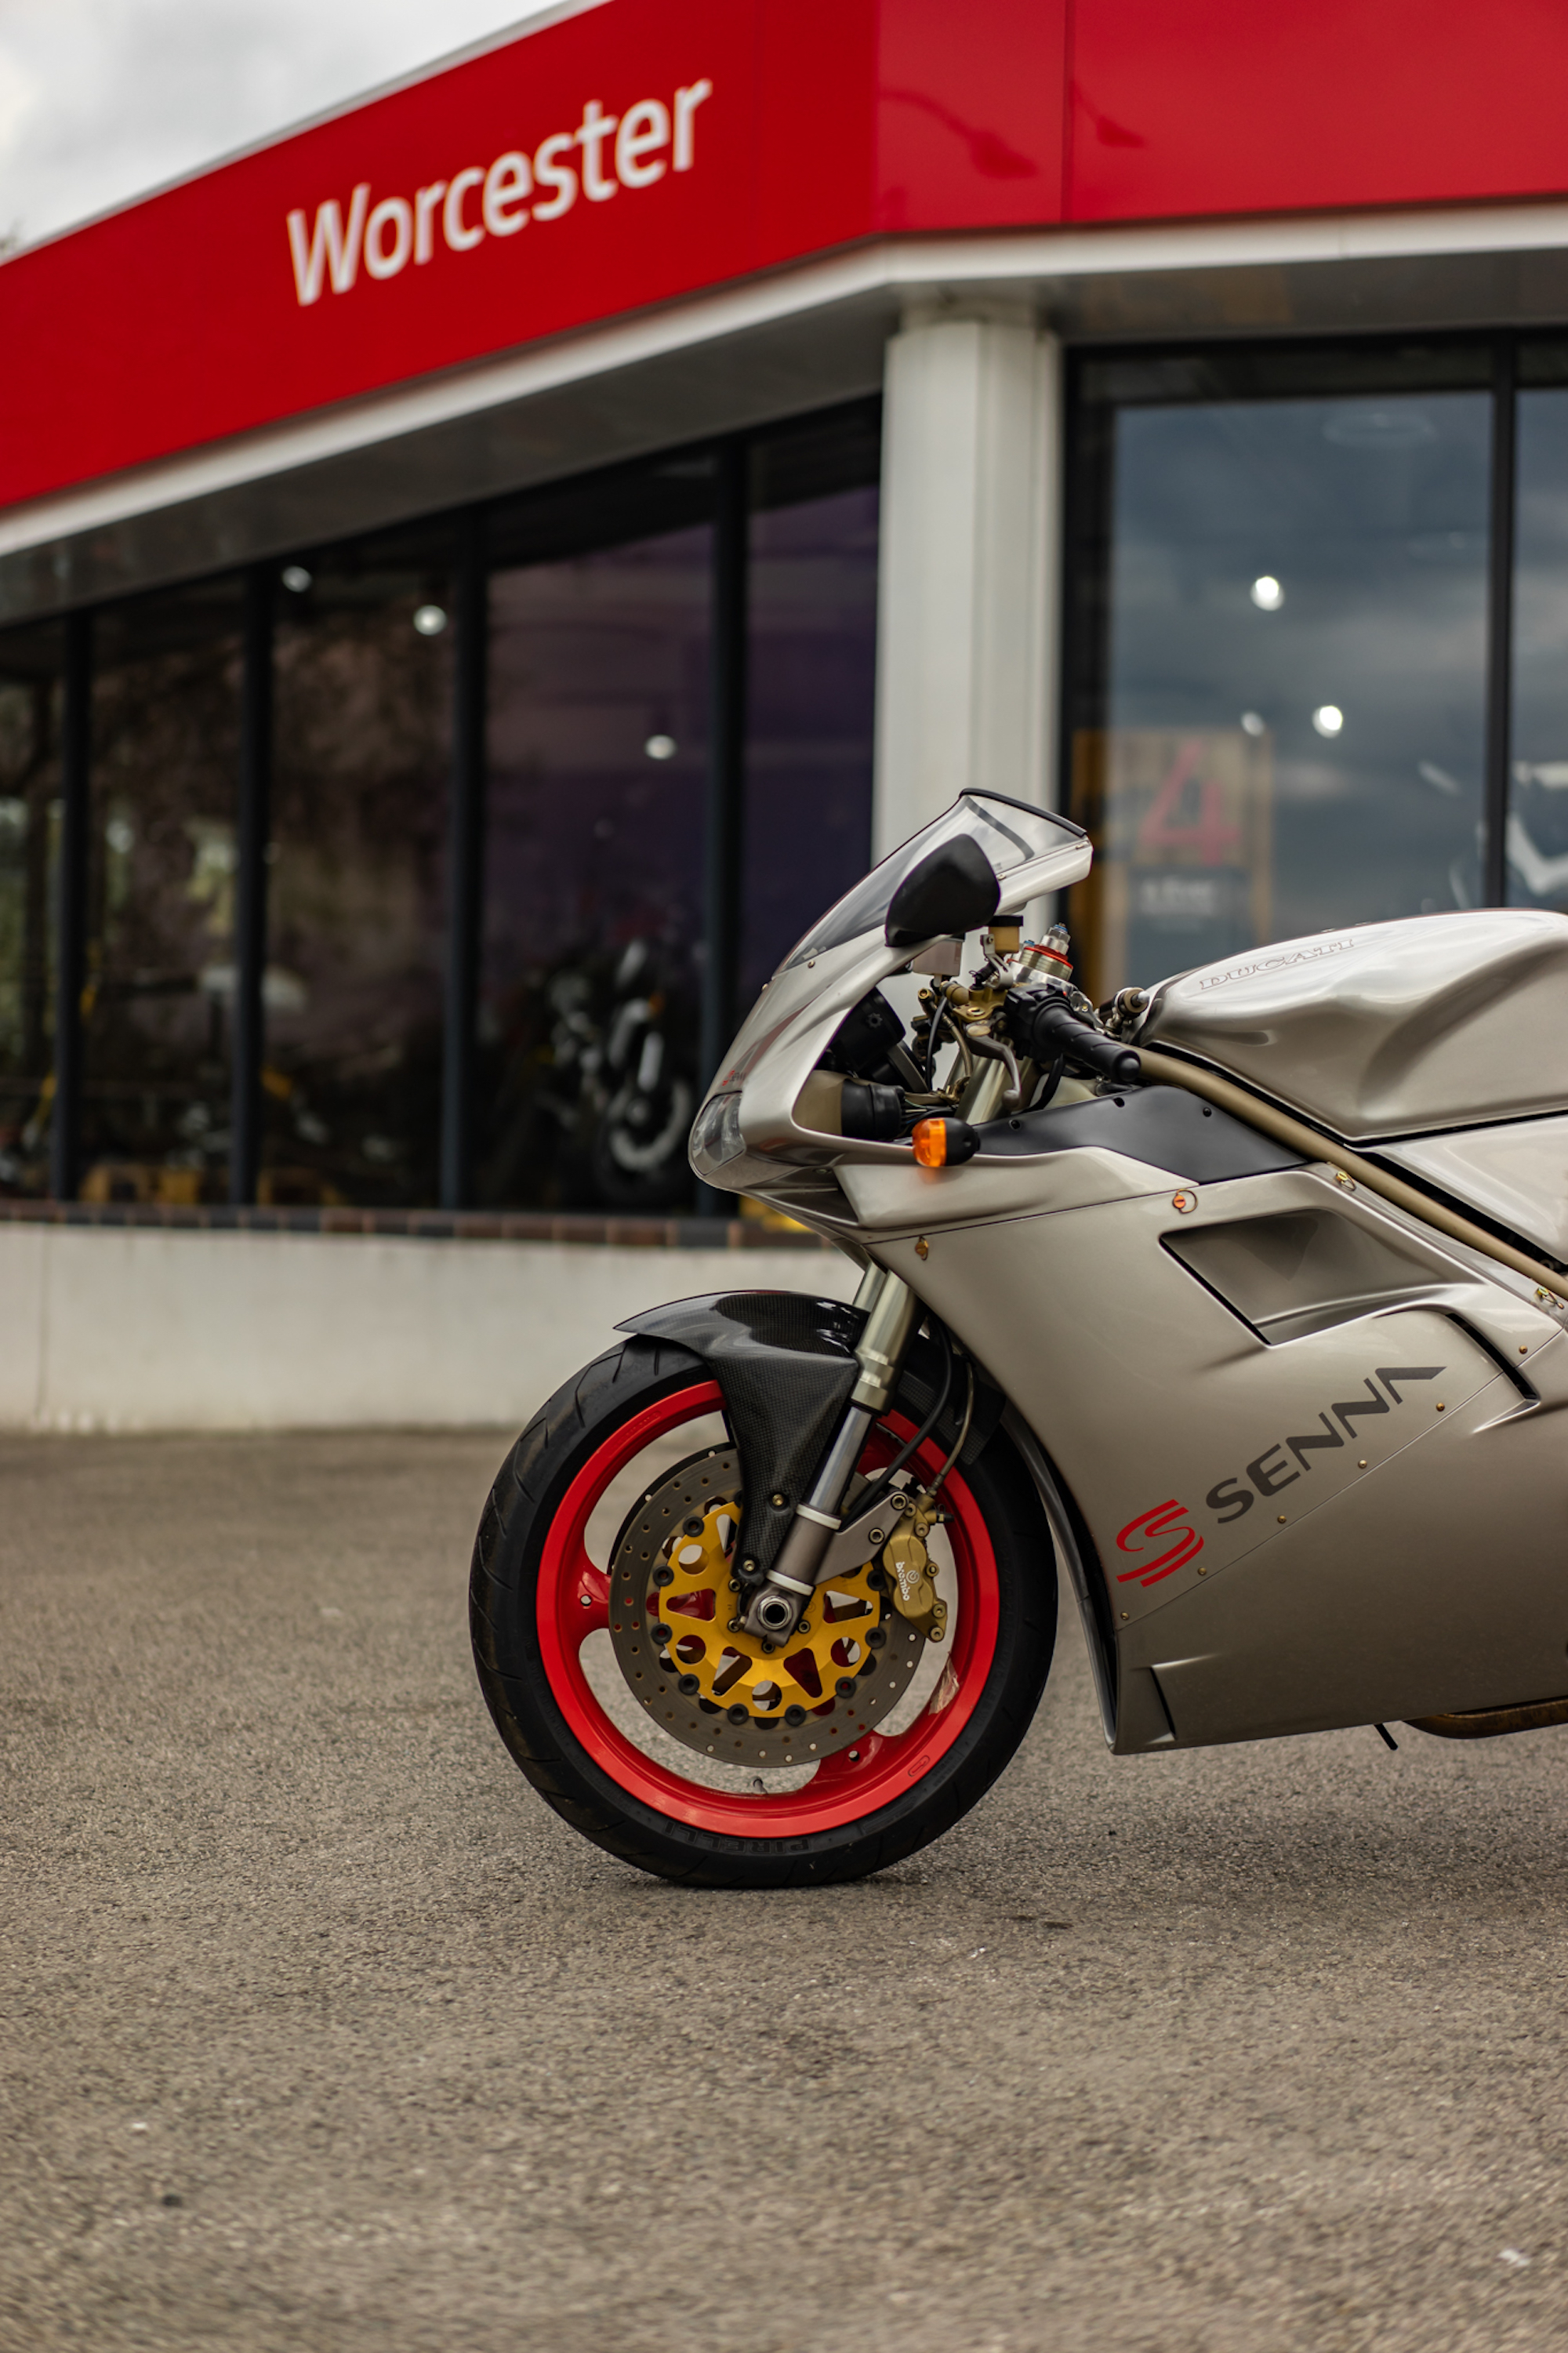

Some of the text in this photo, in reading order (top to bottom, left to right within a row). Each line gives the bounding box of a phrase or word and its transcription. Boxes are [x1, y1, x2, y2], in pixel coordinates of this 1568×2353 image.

[286, 78, 713, 307] Worcester
[1200, 939, 1355, 989] DUCATI
[1206, 1366, 1447, 1524] SENNA
[895, 1561, 910, 1601] brembo
[663, 1821, 814, 1855] PIRELLI
